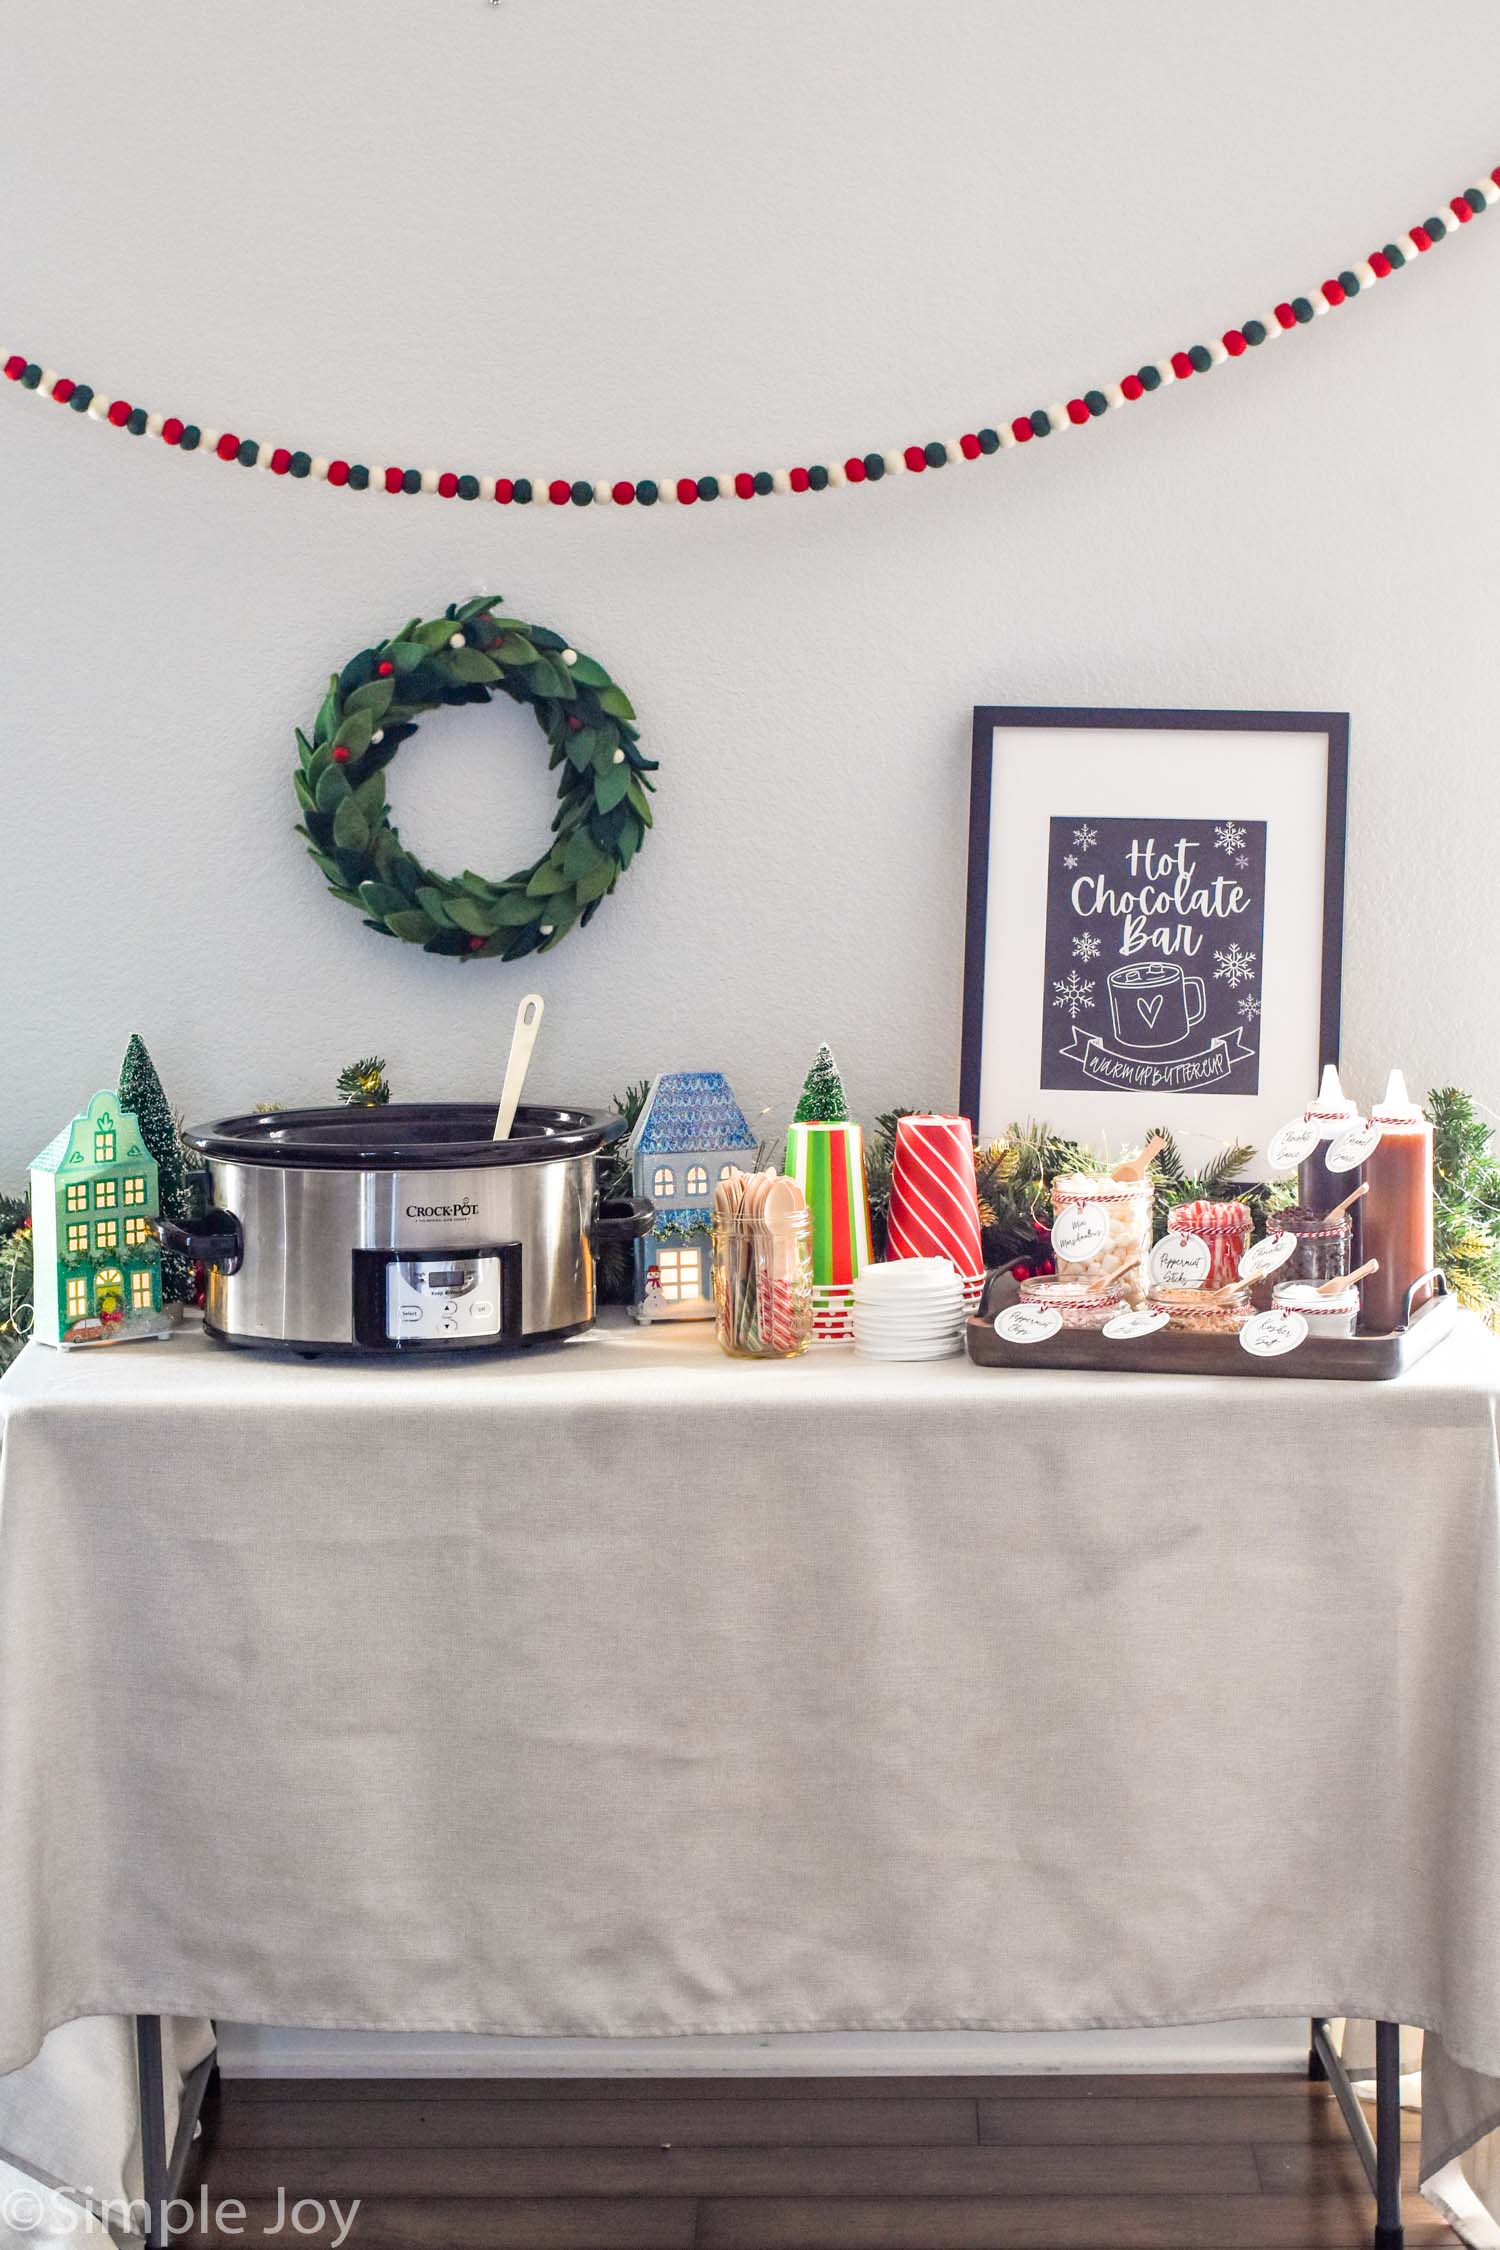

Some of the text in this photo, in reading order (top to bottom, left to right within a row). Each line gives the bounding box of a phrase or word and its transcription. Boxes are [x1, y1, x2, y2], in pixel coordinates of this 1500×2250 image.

[1126, 838, 1200, 880] Hot
[1071, 872, 1251, 917] Chocolate
[1119, 914, 1203, 956] Bar
[1089, 1053, 1223, 1086] WARM UP BUTTERCUP
[1160, 1252, 1204, 1269] Peppermint
